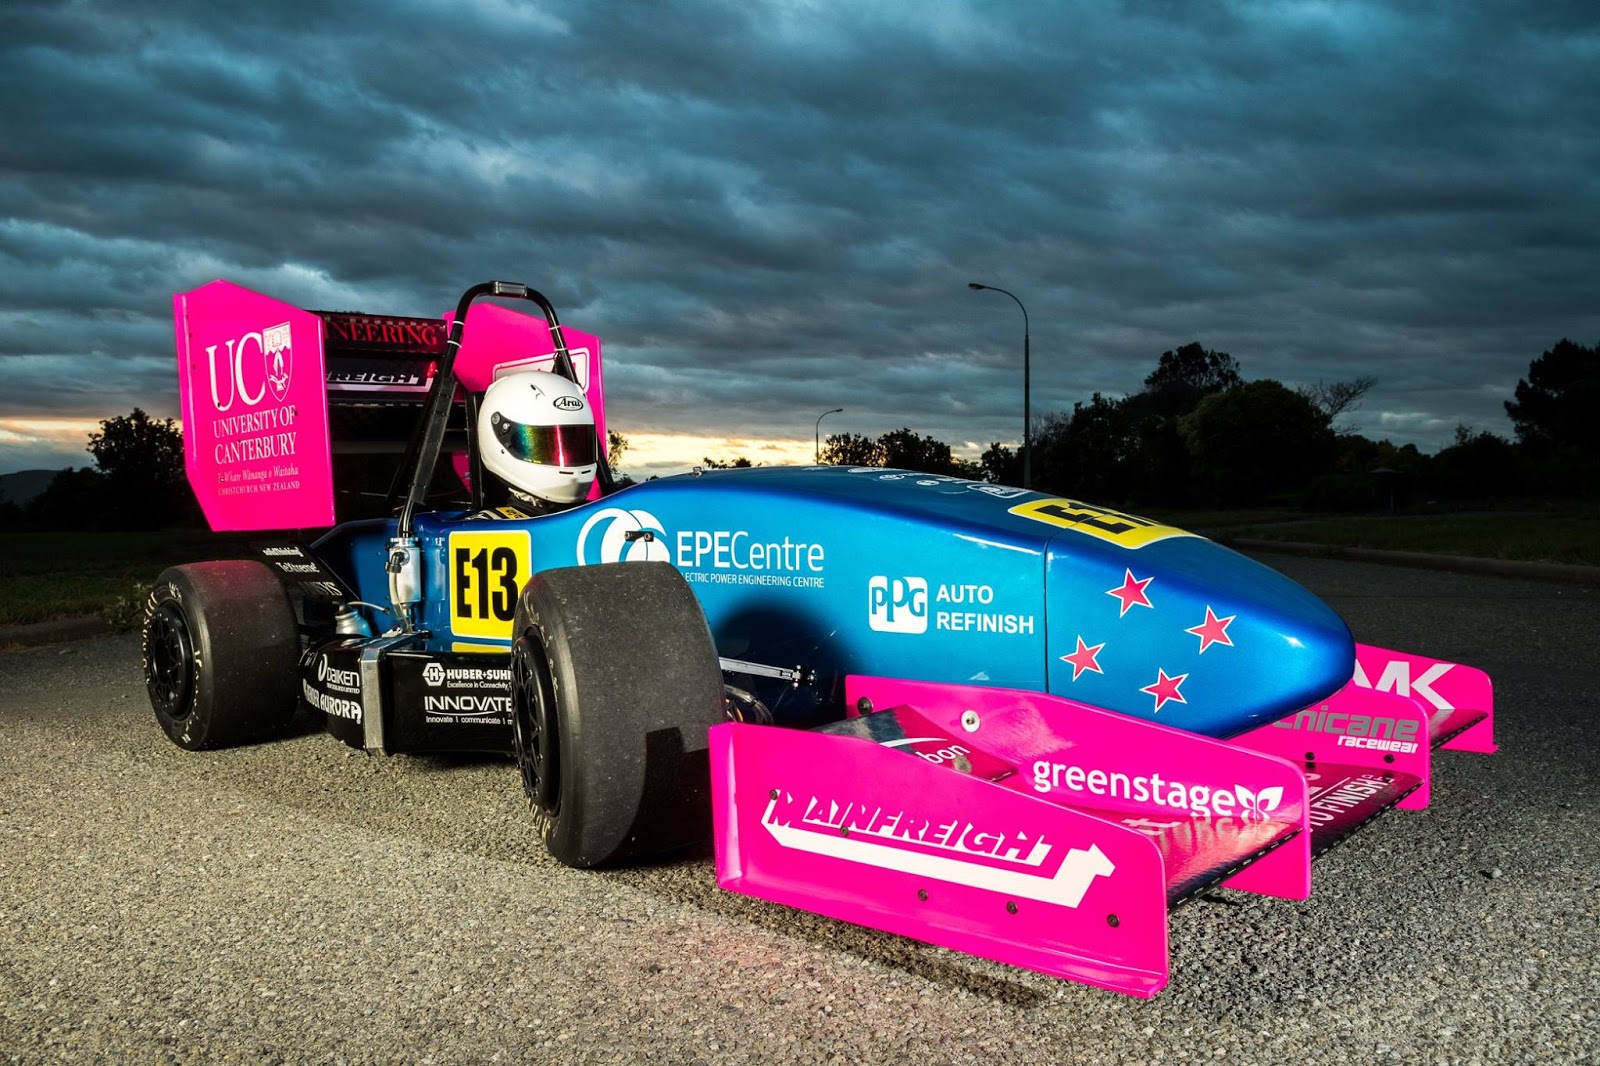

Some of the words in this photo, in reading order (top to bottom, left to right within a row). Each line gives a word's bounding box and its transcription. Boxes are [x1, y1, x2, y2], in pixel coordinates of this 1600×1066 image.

[205, 332, 266, 411] UC
[557, 398, 581, 407] Arai
[213, 408, 279, 438] UNIVERSITY
[280, 405, 296, 426] OF
[214, 431, 297, 464] CANTERBURY
[273, 462, 299, 477] Waitaha
[260, 483, 271, 492] NEW
[273, 480, 300, 491] ZEALAND
[676, 531, 825, 571] EPECentre
[456, 547, 518, 621] E13
[711, 574, 737, 584] POWER
[738, 575, 792, 587] ENGINEERING
[793, 577, 825, 588] CENTRE
[936, 584, 994, 604] AUTO
[871, 576, 926, 622] PPG
[936, 611, 1034, 635] REFINISH
[446, 681, 474, 689] Excellence
[320, 693, 362, 724] AURORA
[424, 696, 512, 712] INNOVATE
[426, 716, 454, 724] Innovate
[461, 716, 501, 725] communicate
[1337, 735, 1419, 754] racewear
[1033, 760, 1236, 818] greenstage
[1311, 778, 1389, 813] FINISH
[762, 788, 1053, 867] MAINFREIGHT
